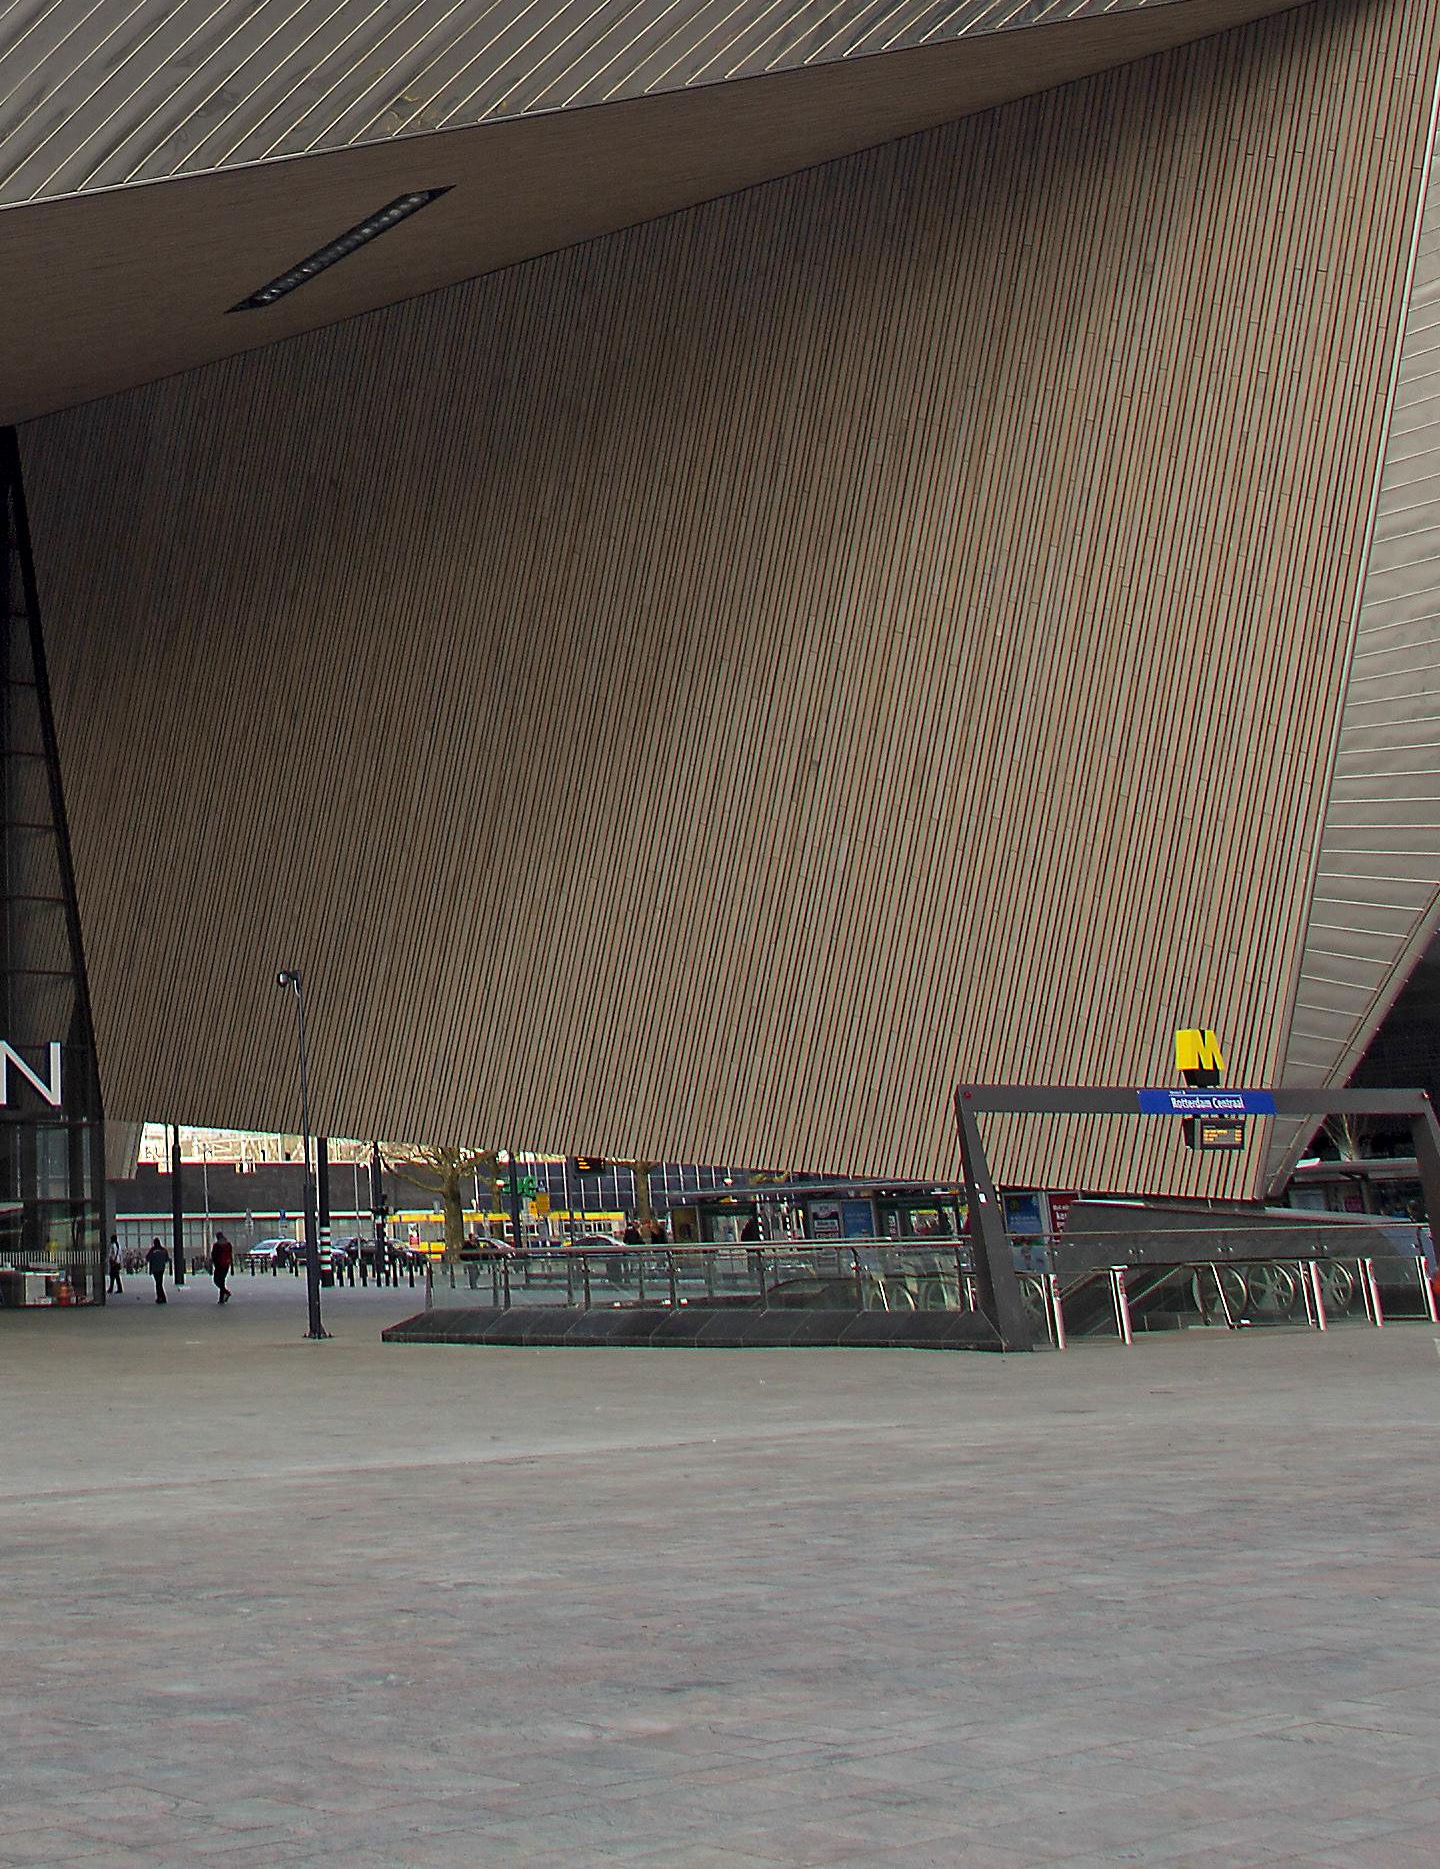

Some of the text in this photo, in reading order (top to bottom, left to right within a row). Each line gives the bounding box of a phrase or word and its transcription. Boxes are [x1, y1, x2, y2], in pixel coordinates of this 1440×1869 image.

[1176, 1029, 1225, 1070] M
[1170, 1097, 1245, 1109] Rotterdam Centraal
